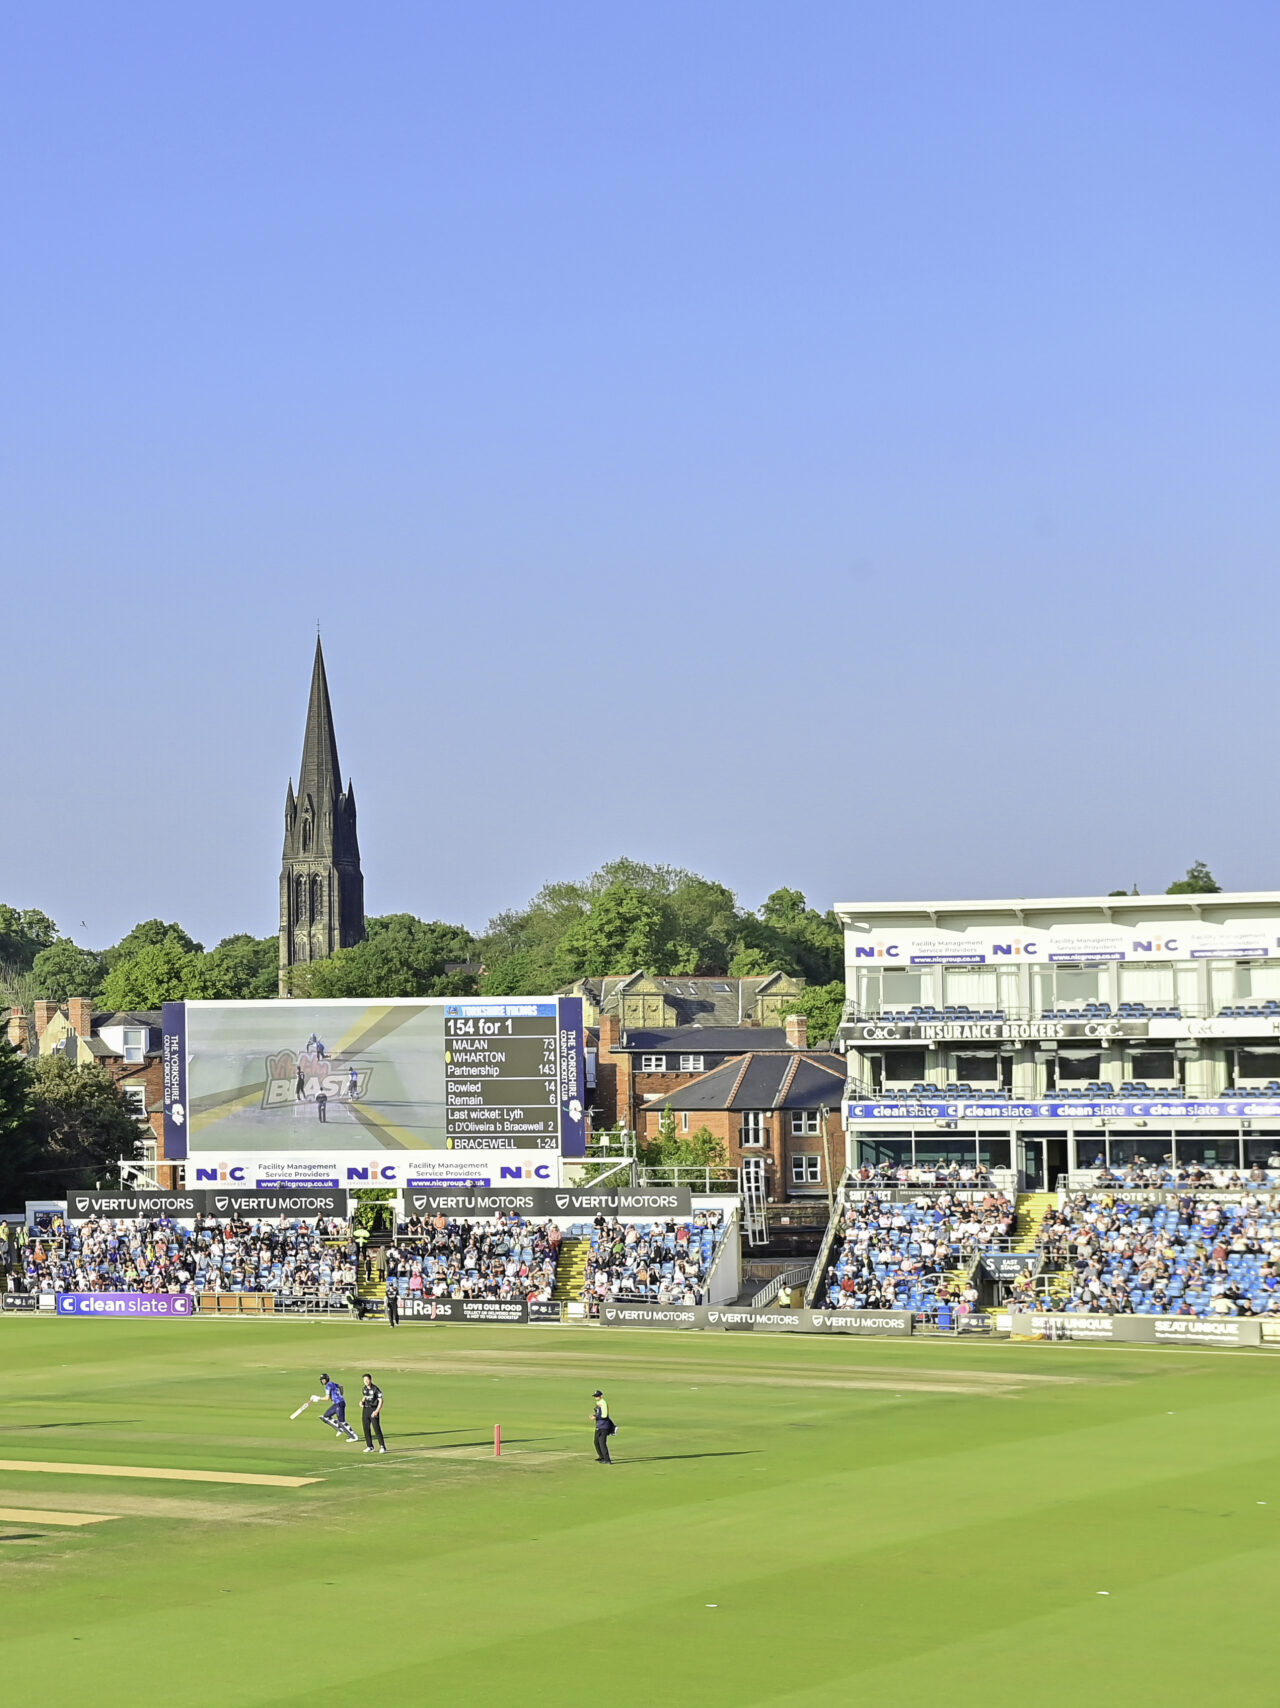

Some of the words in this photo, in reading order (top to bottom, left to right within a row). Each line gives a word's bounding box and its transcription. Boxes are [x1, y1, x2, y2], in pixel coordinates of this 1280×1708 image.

[937, 940, 983, 948] Management
[447, 1019, 475, 1035] 154
[478, 1018, 501, 1034] for
[505, 1018, 513, 1034] 1
[920, 1025, 997, 1039] INSURANCE
[1002, 1024, 1064, 1038] BROKERS
[171, 1035, 179, 1052] THE
[452, 1040, 488, 1050] MALAN
[543, 1039, 555, 1050] 73
[567, 1030, 576, 1047] THE
[453, 1052, 506, 1063] WHARTON
[543, 1051, 555, 1062] 74
[447, 1065, 500, 1078] Partnership
[538, 1064, 556, 1075] 143
[567, 1049, 577, 1098] YORKSHIRE
[171, 1054, 180, 1101] YORKSHIRE
[448, 1082, 482, 1093] Bowled
[544, 1081, 556, 1092] 14
[448, 1095, 484, 1105] Remain
[549, 1093, 556, 1104] 6
[448, 1109, 468, 1120] Last
[468, 1108, 501, 1119] wicket:
[503, 1108, 524, 1121] Lyth
[873, 1106, 908, 1116] clean
[908, 1106, 939, 1116] slate
[965, 1106, 1001, 1116] clean
[1001, 1106, 1033, 1116] slate
[1057, 1105, 1093, 1115] clean
[1094, 1105, 1126, 1115] slate
[1149, 1105, 1187, 1115] clean
[1187, 1105, 1220, 1115] slate
[455, 1122, 495, 1131] D'Oliveira
[496, 1121, 503, 1131] b
[504, 1121, 544, 1131] Bracewell
[548, 1121, 554, 1131] 2
[454, 1139, 517, 1149] BRACEWELL
[536, 1139, 557, 1149] 1-24
[258, 1163, 285, 1171] Facility
[287, 1163, 337, 1171] Management
[408, 1162, 436, 1170] Facility
[438, 1162, 488, 1170] Management
[91, 1198, 137, 1211] VERTU
[138, 1198, 194, 1210] MOTORS
[231, 1198, 277, 1210] VERTU
[278, 1197, 334, 1210] MOTORS
[429, 1197, 476, 1209] VERTU
[477, 1196, 534, 1208] MOTORS
[572, 1195, 619, 1208] VERTU
[620, 1195, 678, 1208] MOTORS
[986, 1258, 995, 1271] S
[1025, 1258, 1035, 1271] T
[80, 1297, 126, 1312] clean
[128, 1298, 168, 1312] slate
[413, 1300, 452, 1319] Rajas
[483, 1303, 500, 1311] OUR
[500, 1304, 522, 1312] FOOD
[617, 1310, 652, 1320] VERTU
[653, 1311, 695, 1321] MOTORS
[720, 1313, 755, 1323] VERTU
[756, 1314, 799, 1325] MOTORS
[824, 1316, 860, 1327] VERTU
[861, 1317, 905, 1329] MOTORS
[1064, 1318, 1113, 1330] UNIQUE
[1154, 1320, 1187, 1332] SEAT
[1188, 1322, 1239, 1334] UNIQUE
